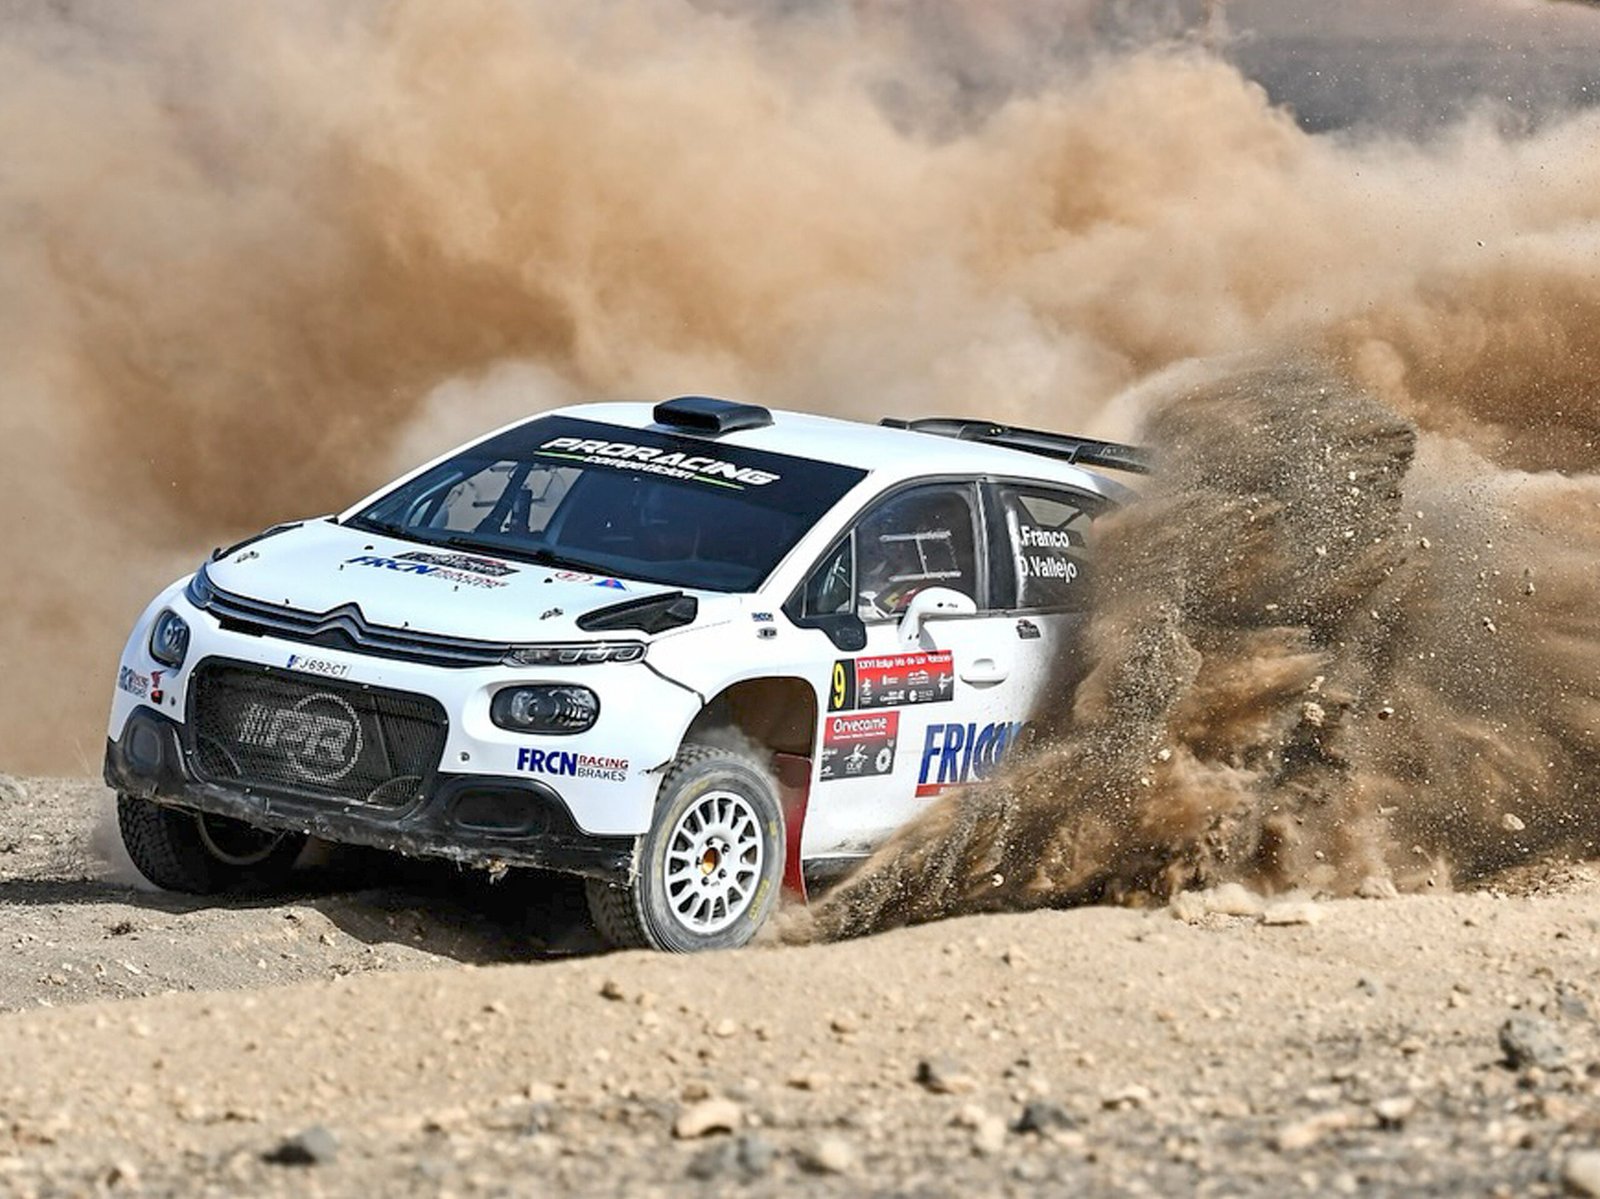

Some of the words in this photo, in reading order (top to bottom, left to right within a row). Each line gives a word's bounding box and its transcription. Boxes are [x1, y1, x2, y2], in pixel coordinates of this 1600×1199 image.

[540, 437, 780, 486] PRORACING
[1016, 556, 1078, 583] D.Vallejo
[833, 662, 846, 709] 9
[833, 717, 888, 733] Orvecame
[517, 747, 579, 777] FRCN
[579, 755, 629, 769] RACING
[577, 767, 627, 782] BRAKES
